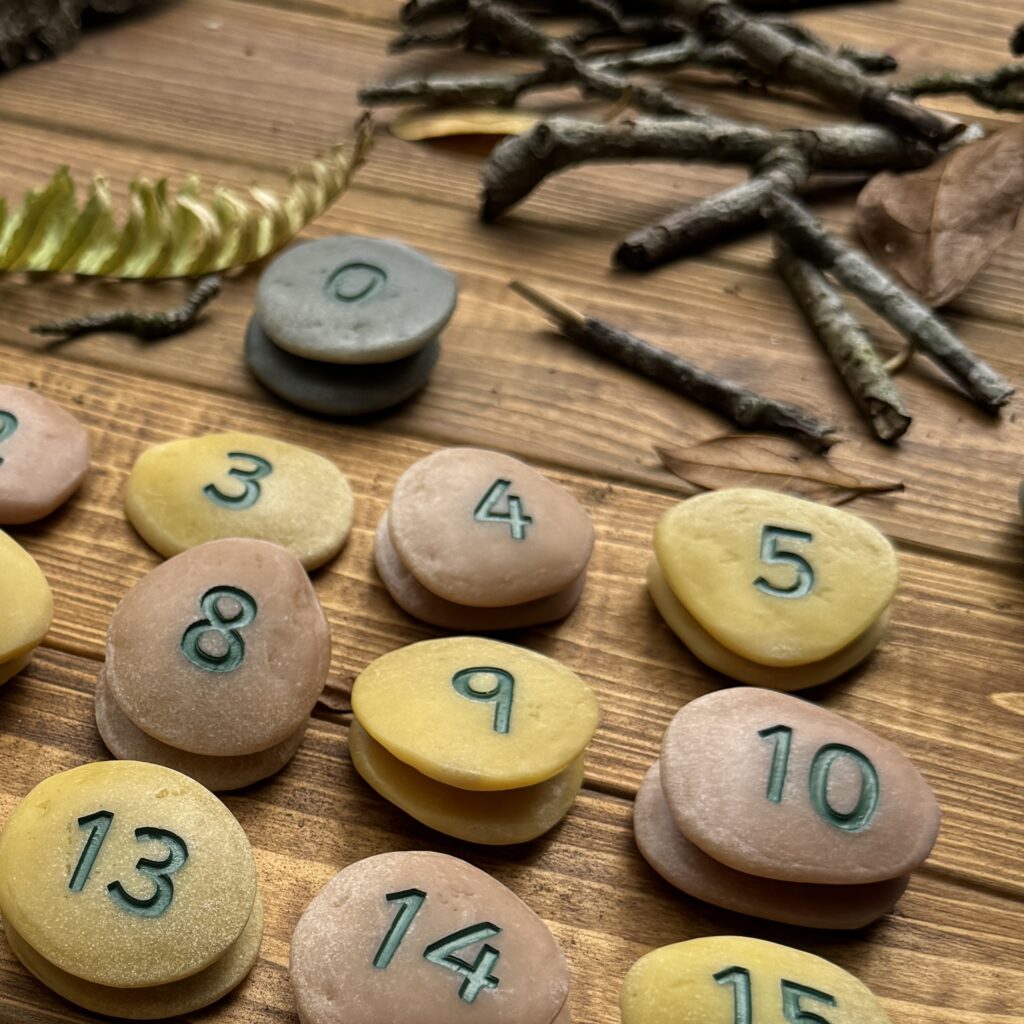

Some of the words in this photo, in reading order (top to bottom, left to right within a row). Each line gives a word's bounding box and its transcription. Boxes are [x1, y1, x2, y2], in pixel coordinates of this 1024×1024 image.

[324, 261, 388, 303] 0
[203, 451, 273, 508] 3
[473, 478, 533, 540] 4
[753, 525, 815, 597] 5
[180, 585, 258, 671] 8
[451, 666, 516, 734] 9
[758, 724, 880, 832] 10
[68, 809, 190, 918] 13
[372, 888, 502, 1004] 14
